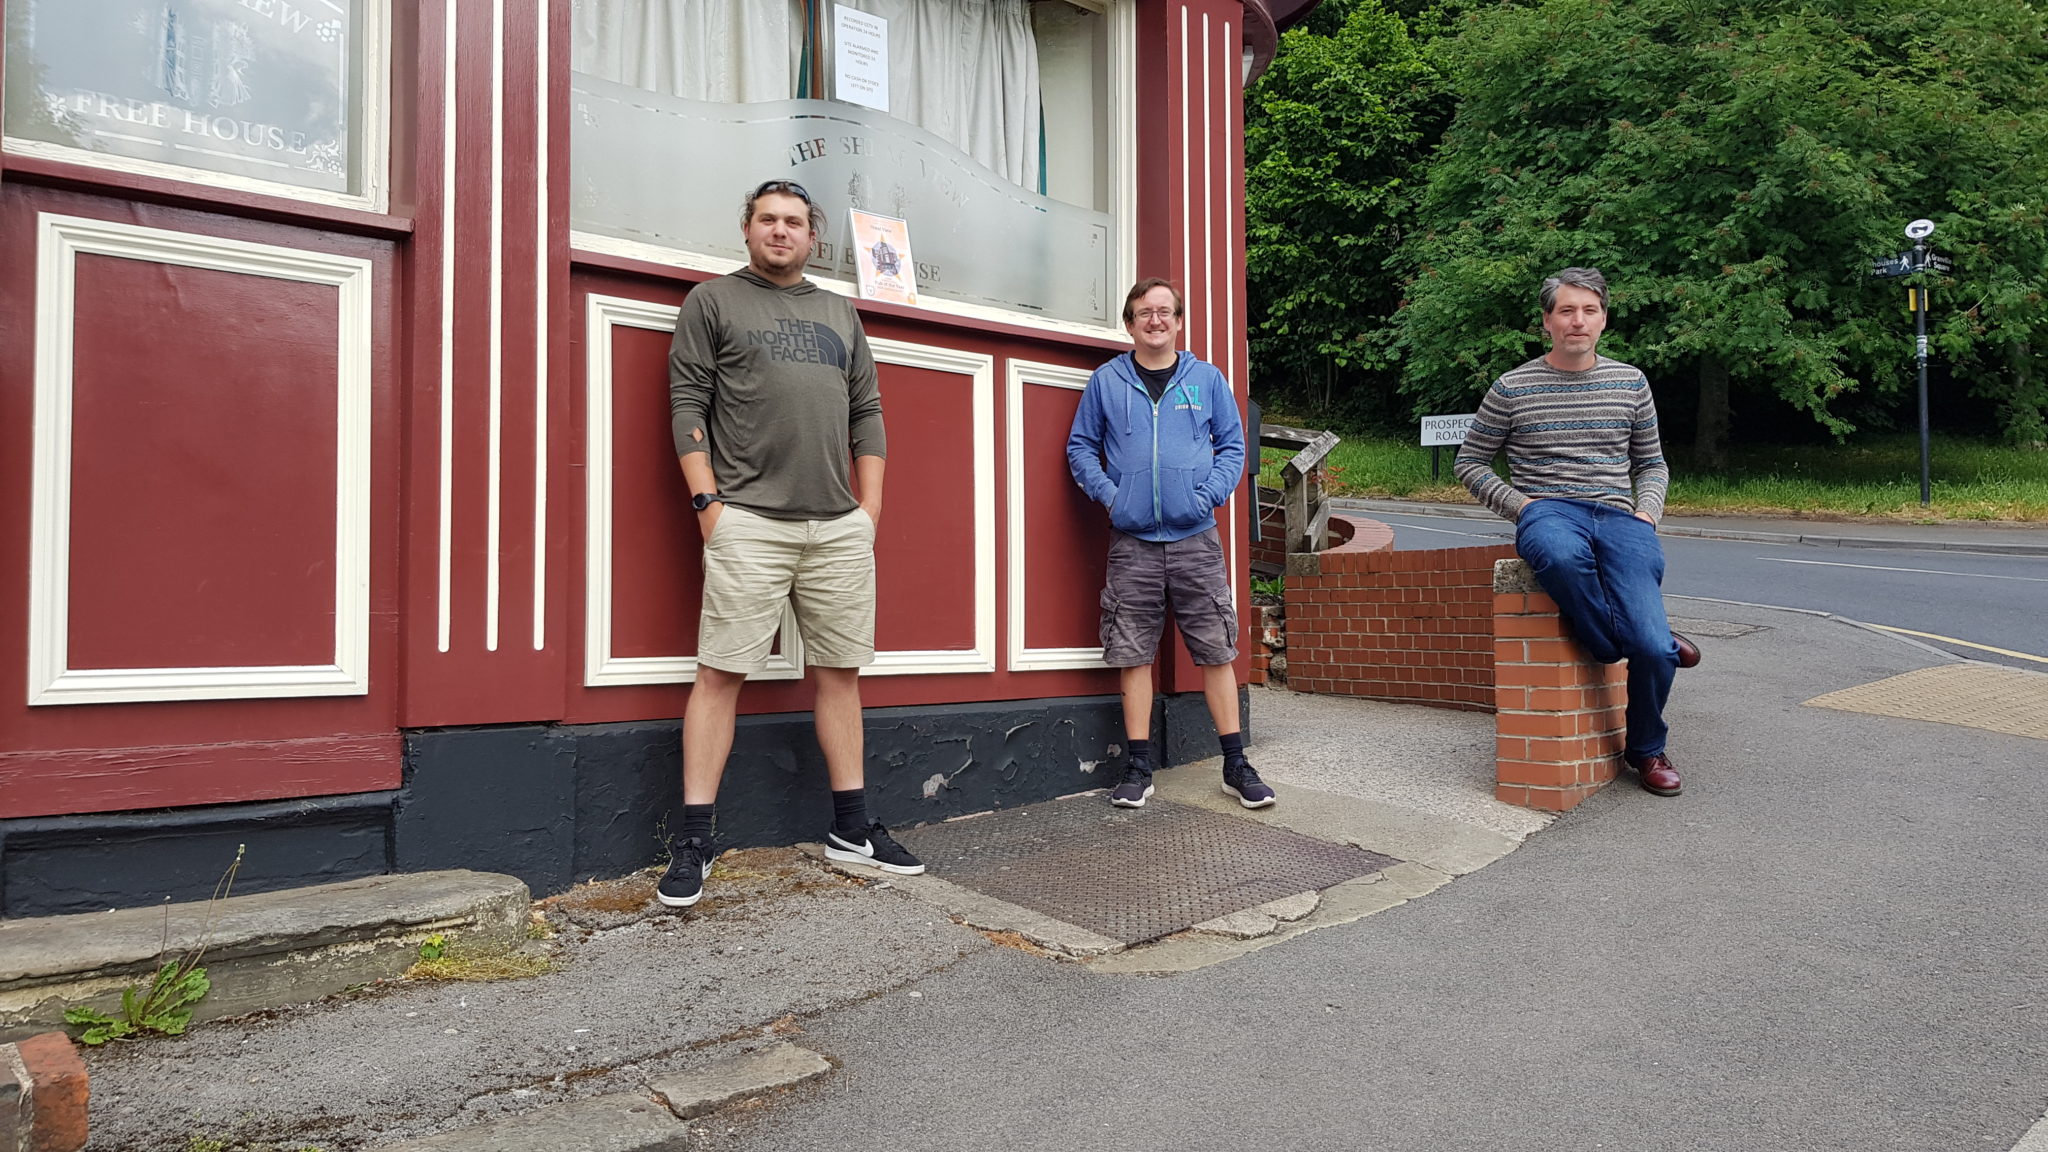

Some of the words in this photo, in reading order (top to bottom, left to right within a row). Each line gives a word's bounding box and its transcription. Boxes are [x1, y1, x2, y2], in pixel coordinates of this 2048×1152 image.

[238, 0, 312, 33] EW
[74, 94, 171, 128] FREE
[181, 109, 307, 155] HOUSE
[787, 138, 827, 167] THE
[775, 318, 813, 334] THE
[747, 329, 816, 349] NORTH
[770, 345, 819, 364] FACE
[1435, 430, 1467, 441] ROAD
